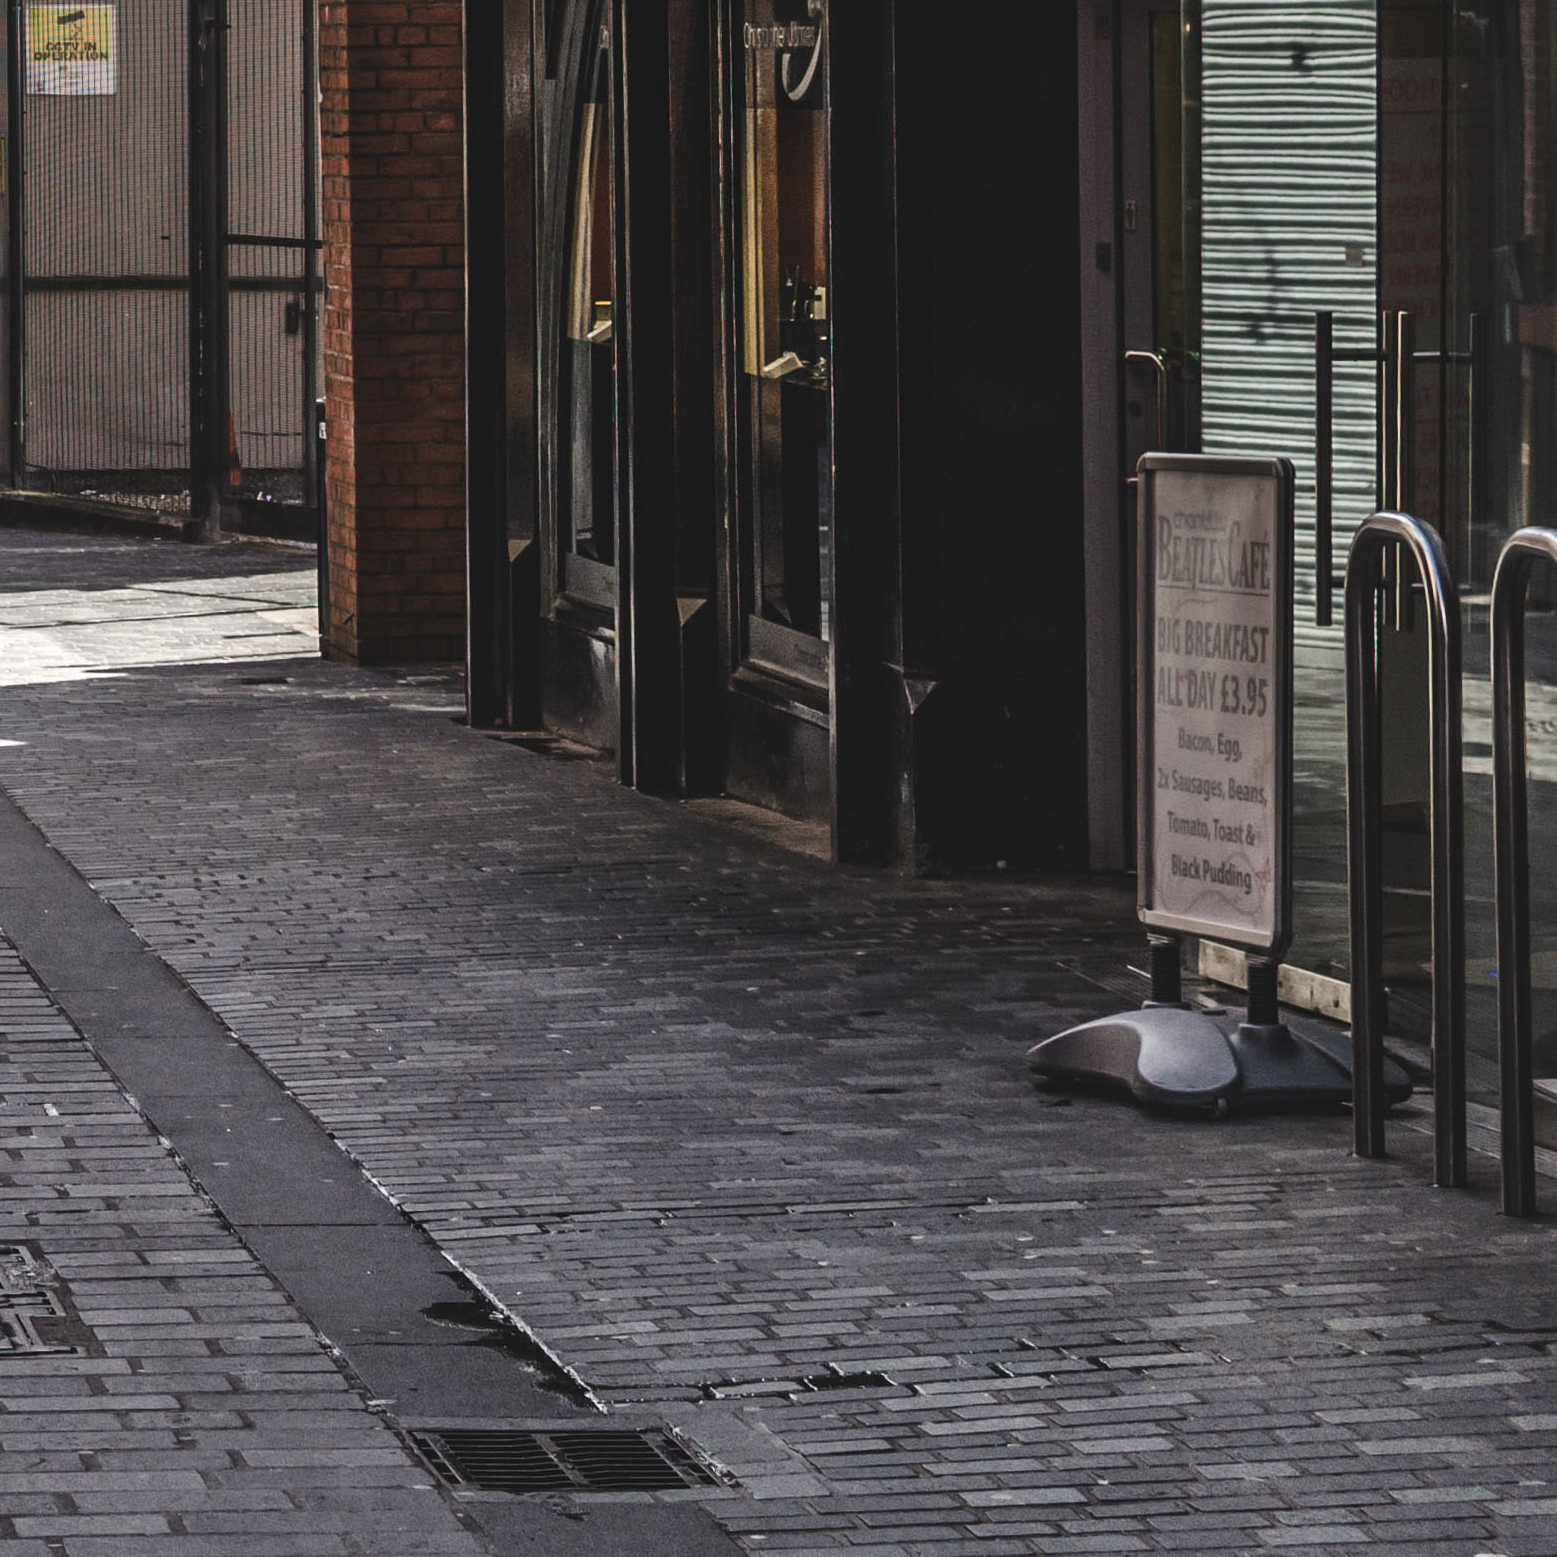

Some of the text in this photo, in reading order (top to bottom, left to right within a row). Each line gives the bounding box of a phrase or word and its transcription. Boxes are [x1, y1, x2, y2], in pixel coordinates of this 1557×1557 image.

[33, 51, 109, 62] OPERATION
[45, 41, 97, 52] CCTV IN
[1157, 616, 1271, 664] BIG BREAKFAST
[1157, 666, 1270, 718] ALL DAY £3.95
[1178, 726, 1244, 763] Bacon, Egg,
[1156, 767, 1269, 808] 2x Sausages, Beans,
[1166, 810, 1212, 842] Tomato,
[1212, 817, 1245, 844] Toast
[1170, 853, 1253, 895] Black Pudding
